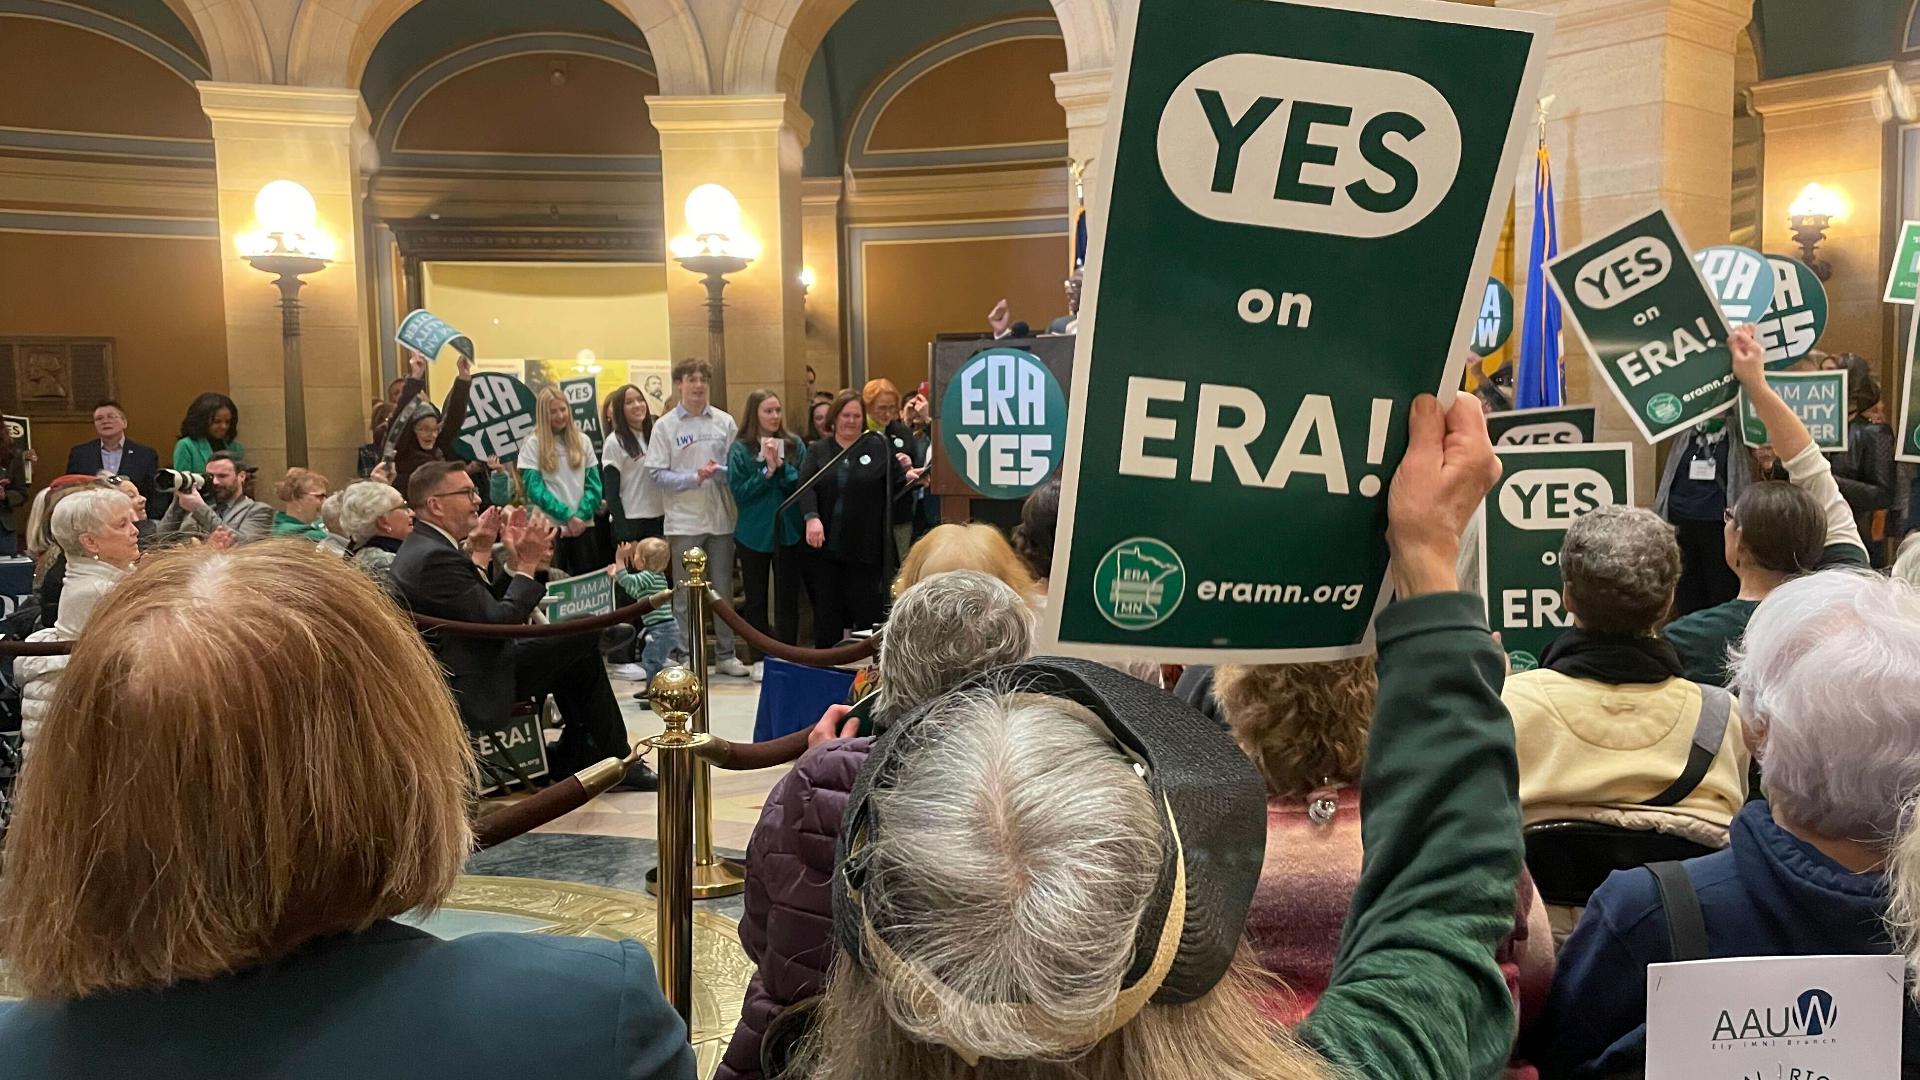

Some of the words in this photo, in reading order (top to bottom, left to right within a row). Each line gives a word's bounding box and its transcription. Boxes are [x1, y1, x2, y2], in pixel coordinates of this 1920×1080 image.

[1194, 88, 1427, 214] YES
[1581, 246, 1664, 300] YES
[1693, 250, 1761, 300] RA
[1237, 288, 1313, 329] on
[1632, 305, 1661, 327] on
[1615, 316, 1717, 387] ERA!
[1755, 309, 1816, 365] ES
[566, 387, 590, 400] YES
[961, 355, 1045, 426] ERA
[1682, 373, 1735, 402] eramn.or
[1807, 384, 1835, 401] AN
[573, 417, 597, 432] RA!
[1118, 375, 1394, 498] ERA!
[956, 434, 1052, 487] YES
[1510, 482, 1600, 520] YES
[1123, 568, 1150, 582] ERA
[1541, 551, 1562, 567] o
[559, 591, 611, 616] EQUALITY
[580, 581, 597, 596] AM
[1196, 579, 1364, 611] eramn.org
[1120, 602, 1142, 615] MN
[1712, 988, 1838, 1041] AAUW
[1786, 1037, 1837, 1046] Branch
